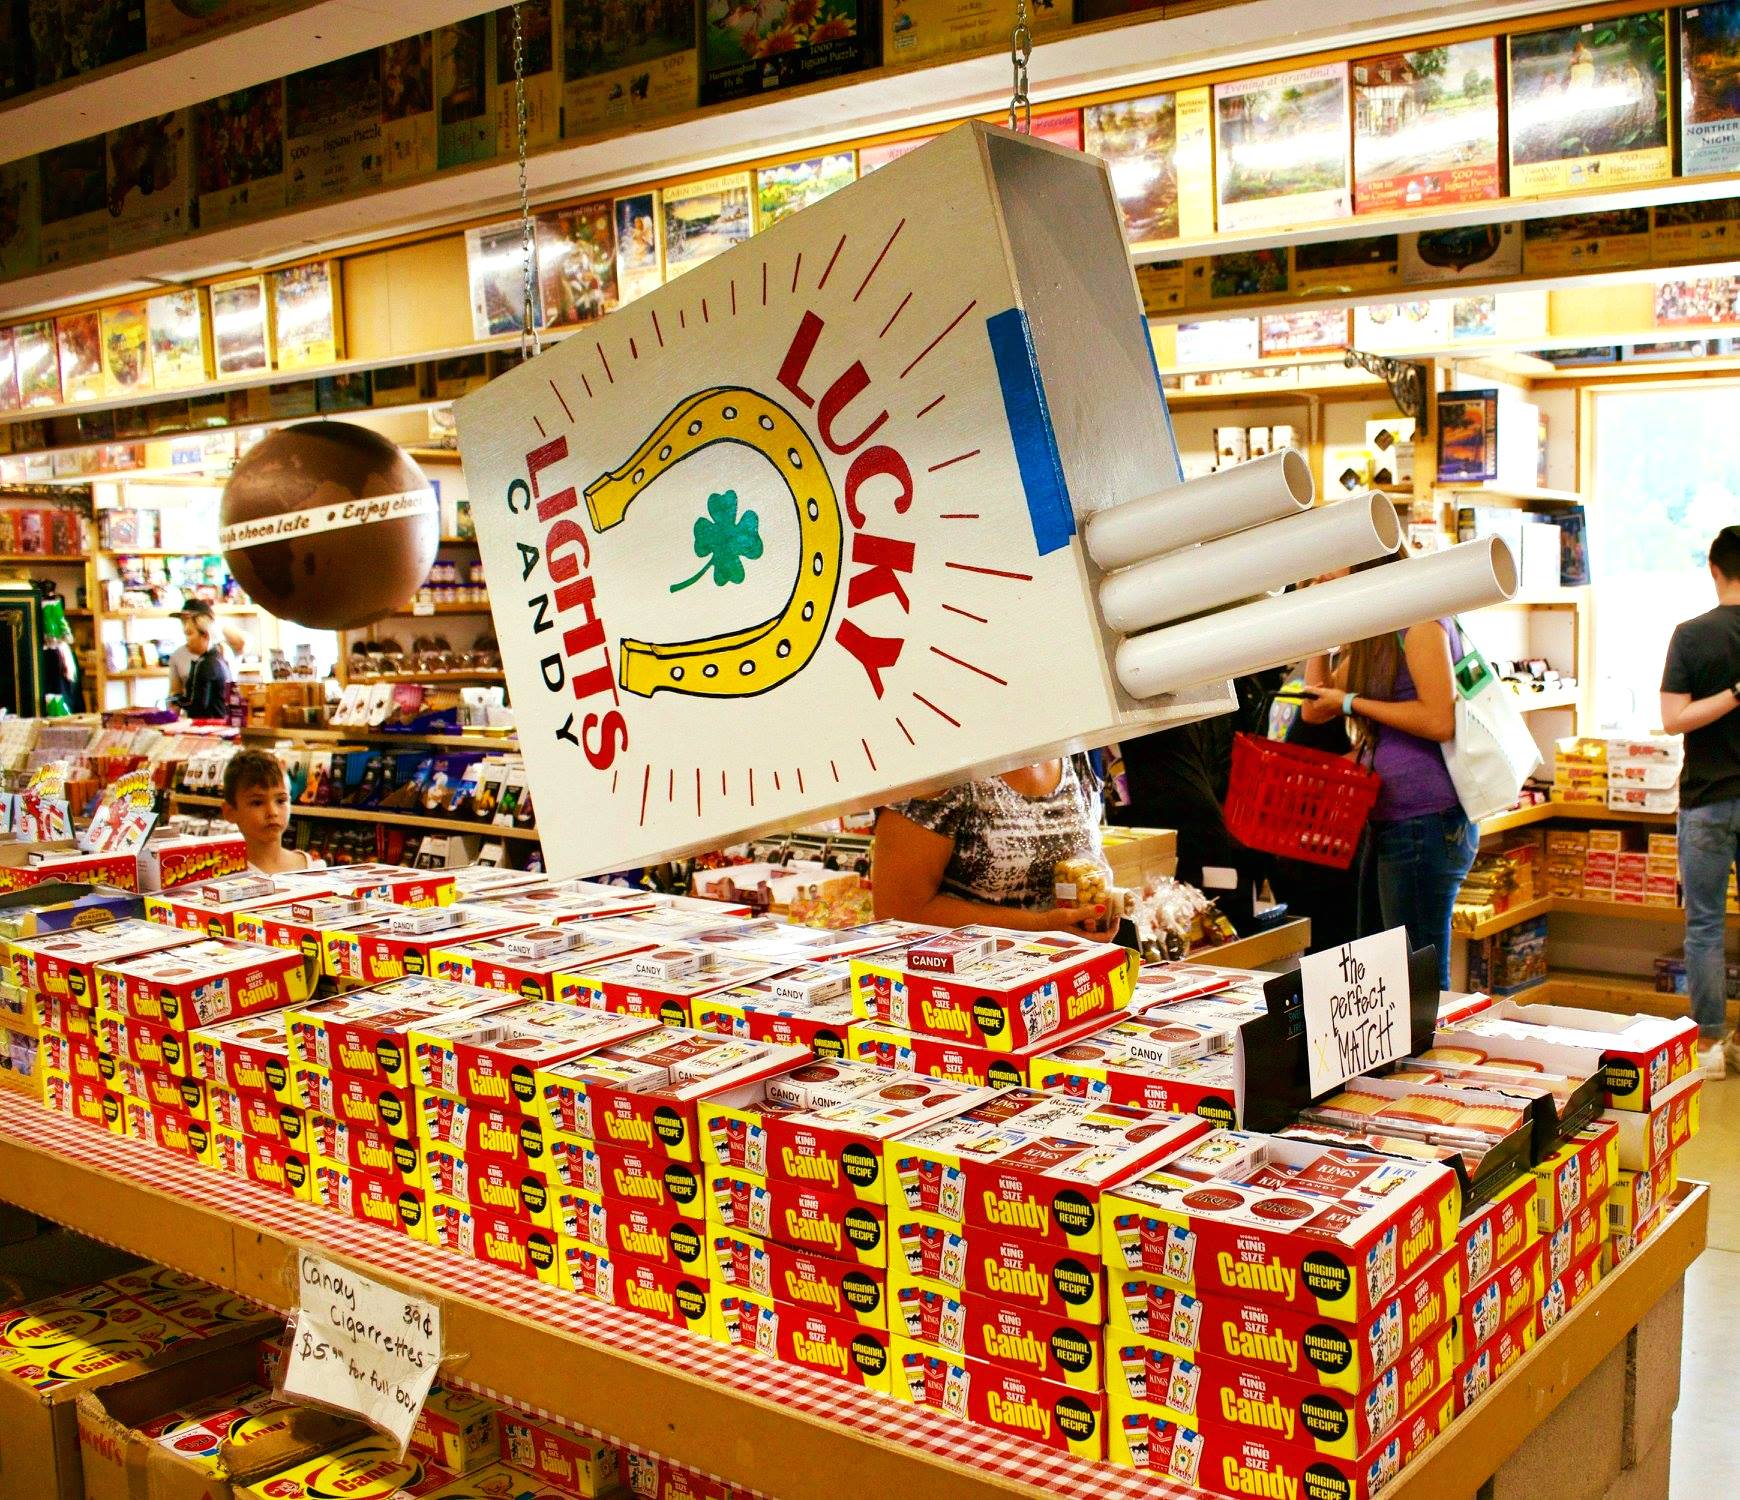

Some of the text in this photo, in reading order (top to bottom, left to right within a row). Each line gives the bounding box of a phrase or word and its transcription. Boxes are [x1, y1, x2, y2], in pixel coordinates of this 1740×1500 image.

[1224, 80, 1266, 95] Evening
[1268, 76, 1279, 87] at
[1687, 123, 1739, 136] NORTHER
[777, 310, 916, 700] LUCKY
[239, 517, 309, 539] chocolate
[343, 503, 389, 523] Enjoy
[525, 435, 628, 770] LIGHTS
[507, 478, 579, 747] CANDY
[166, 850, 222, 886] BUBBLE
[393, 921, 414, 931] CANDY
[508, 944, 530, 955] CANDY
[636, 964, 661, 976] CANDY
[912, 956, 947, 968] CANDY
[1339, 943, 1365, 984] the
[43, 972, 69, 1001] Candy
[1073, 972, 1090, 988] KING
[238, 980, 279, 1008] Candy
[776, 988, 804, 1000] CANDY
[932, 990, 950, 1000] KING
[1077, 982, 1091, 996] SIZE
[935, 999, 950, 1008] SIZE
[1067, 981, 1105, 1020] Candy
[1330, 977, 1385, 1031] perfect
[133, 994, 162, 1024] Candy
[922, 1001, 970, 1039] Candy
[339, 1044, 378, 1076] Candy
[943, 1054, 963, 1065] KING
[1131, 1046, 1163, 1062] CANDY
[946, 1063, 963, 1074] SIZE
[233, 1063, 267, 1093] Candy
[469, 1068, 510, 1104] Candy
[770, 1087, 800, 1103] CANDY
[1144, 1089, 1167, 1099] KING
[342, 1094, 379, 1126] Candy
[614, 1100, 632, 1110] KING
[1147, 1100, 1166, 1109] SIZE
[617, 1110, 632, 1119] SIZE
[604, 1111, 653, 1148] Candy
[480, 1122, 518, 1159] Candy
[795, 1135, 816, 1147] KING
[358, 1141, 393, 1174] Candy
[798, 1145, 815, 1156] SIZE
[1024, 1148, 1063, 1160] KINGS
[782, 1147, 838, 1189] Candy
[843, 1153, 876, 1169] ORIGINAL
[253, 1156, 285, 1188] Candy
[847, 1165, 872, 1178] RECIPE
[1317, 1164, 1360, 1178] KINGS
[613, 1168, 663, 1206] Candy
[1000, 1179, 1023, 1192] KING
[1298, 1180, 1338, 1192] CANDY
[479, 1178, 519, 1214] Candy
[799, 1198, 819, 1209] KING
[1003, 1190, 1022, 1201] SIZE
[361, 1193, 397, 1227] Candy
[802, 1208, 818, 1219] SIZE
[983, 1191, 1049, 1237] Candy
[1054, 1200, 1092, 1217] ORIGINAL
[845, 1216, 878, 1232] ORIGINAL
[1060, 1213, 1088, 1227] RECIPE
[785, 1209, 841, 1252] Candy
[850, 1229, 875, 1242] RECIPE
[485, 1232, 525, 1270] Candy
[619, 1224, 668, 1263] Candy
[1237, 1239, 1266, 1252] KING
[1402, 1218, 1434, 1270] Candy
[1000, 1246, 1024, 1259] KING
[1241, 1251, 1265, 1263] SIZE
[796, 1262, 816, 1273] KING
[1003, 1257, 1023, 1270] SIZE
[1304, 1262, 1346, 1280] ORIGINAL
[302, 1256, 355, 1311] Candy
[800, 1271, 816, 1282] SIZE
[984, 1259, 1049, 1305] Candy
[1054, 1268, 1091, 1286] ORIGINAL
[1218, 1252, 1296, 1302] Candy
[1309, 1276, 1342, 1292] RECIPE
[785, 1271, 840, 1312] Candy
[843, 1279, 877, 1295] ORIGINAL
[1059, 1281, 1087, 1297] RECIPE
[626, 1279, 674, 1319] Candy
[848, 1291, 873, 1304] RECIPE
[998, 1313, 1022, 1326] KING
[1241, 1309, 1269, 1323] KING
[1409, 1292, 1440, 1344] Candy
[806, 1322, 827, 1333] KING
[1001, 1324, 1021, 1336] SIZE
[1245, 1322, 1268, 1334] SIZE
[330, 1305, 423, 1367] Cigarrettes
[809, 1332, 826, 1343] SIZE
[1305, 1333, 1349, 1353] ORIGINAL
[852, 1342, 884, 1358] ORIGINAL
[983, 1325, 1048, 1372] Candy
[1052, 1336, 1089, 1354] ORIGINAL
[1222, 1321, 1298, 1372] Candy
[72, 1347, 146, 1375] Candy
[793, 1332, 848, 1375] Candy
[857, 1354, 880, 1368] RECIPE
[1057, 1349, 1085, 1364] RECIPE
[1310, 1348, 1343, 1365] RECIPE
[349, 1358, 365, 1381] for
[370, 1370, 389, 1395] full
[396, 1386, 417, 1414] box
[1003, 1381, 1026, 1393] KING
[1239, 1377, 1266, 1391] KING
[1405, 1358, 1434, 1410] Candy
[1007, 1392, 1025, 1404] SIZE
[1243, 1389, 1265, 1402] SIZE
[987, 1392, 1050, 1440] Candy
[1056, 1405, 1092, 1424] ORIGINAL
[1220, 1388, 1295, 1440] Candy
[1302, 1402, 1344, 1422] ORIGINAL
[1061, 1418, 1089, 1433] RECIPE
[1306, 1417, 1340, 1433] RECIPE
[1242, 1444, 1270, 1459] KING
[540, 1451, 572, 1481] Candy
[1246, 1458, 1268, 1470] SIZE
[1222, 1457, 1298, 1500] Candy
[1305, 1472, 1347, 1492] ORIGINAL
